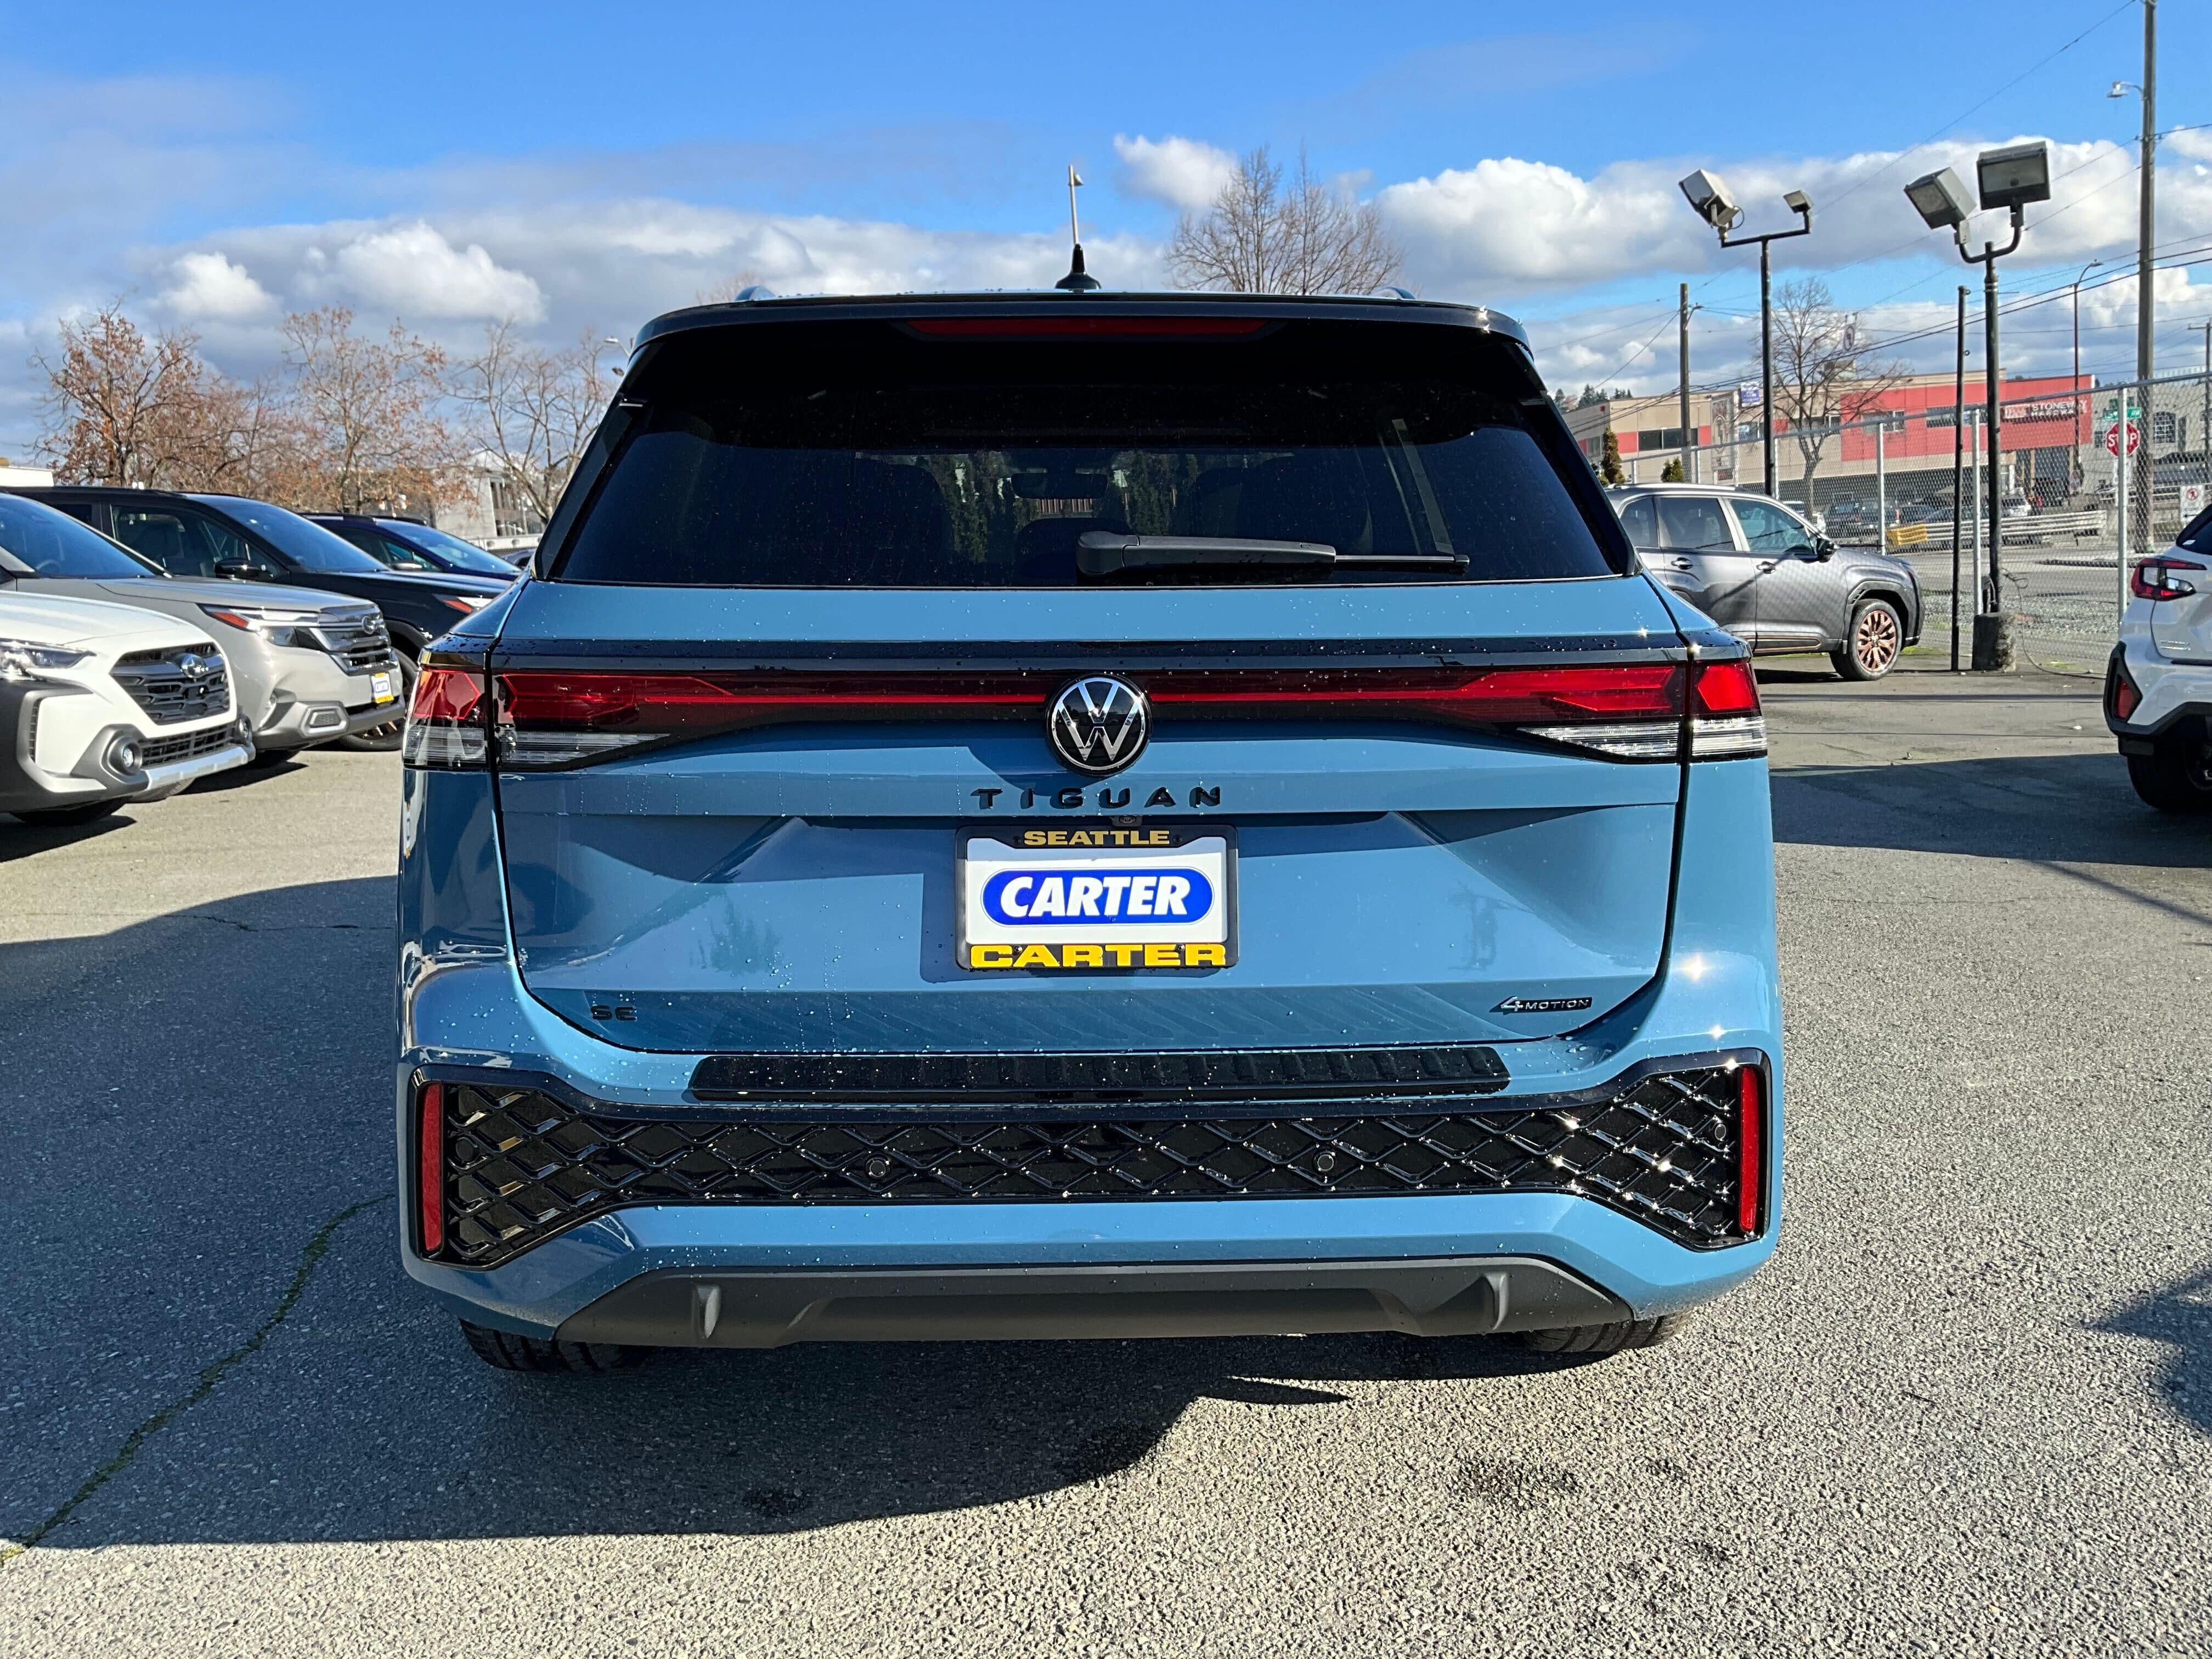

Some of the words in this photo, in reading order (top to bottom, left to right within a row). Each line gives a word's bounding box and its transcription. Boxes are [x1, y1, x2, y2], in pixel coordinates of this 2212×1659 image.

[2108, 433, 2137, 447] STP
[974, 786, 1221, 808] TIGUAN
[1024, 830, 1170, 845] SEATTLE
[1000, 876, 1190, 917] CARTER
[970, 944, 1226, 967] CARTER
[1500, 996, 1589, 1012] 4MOTION
[591, 1005, 637, 1020] SE
